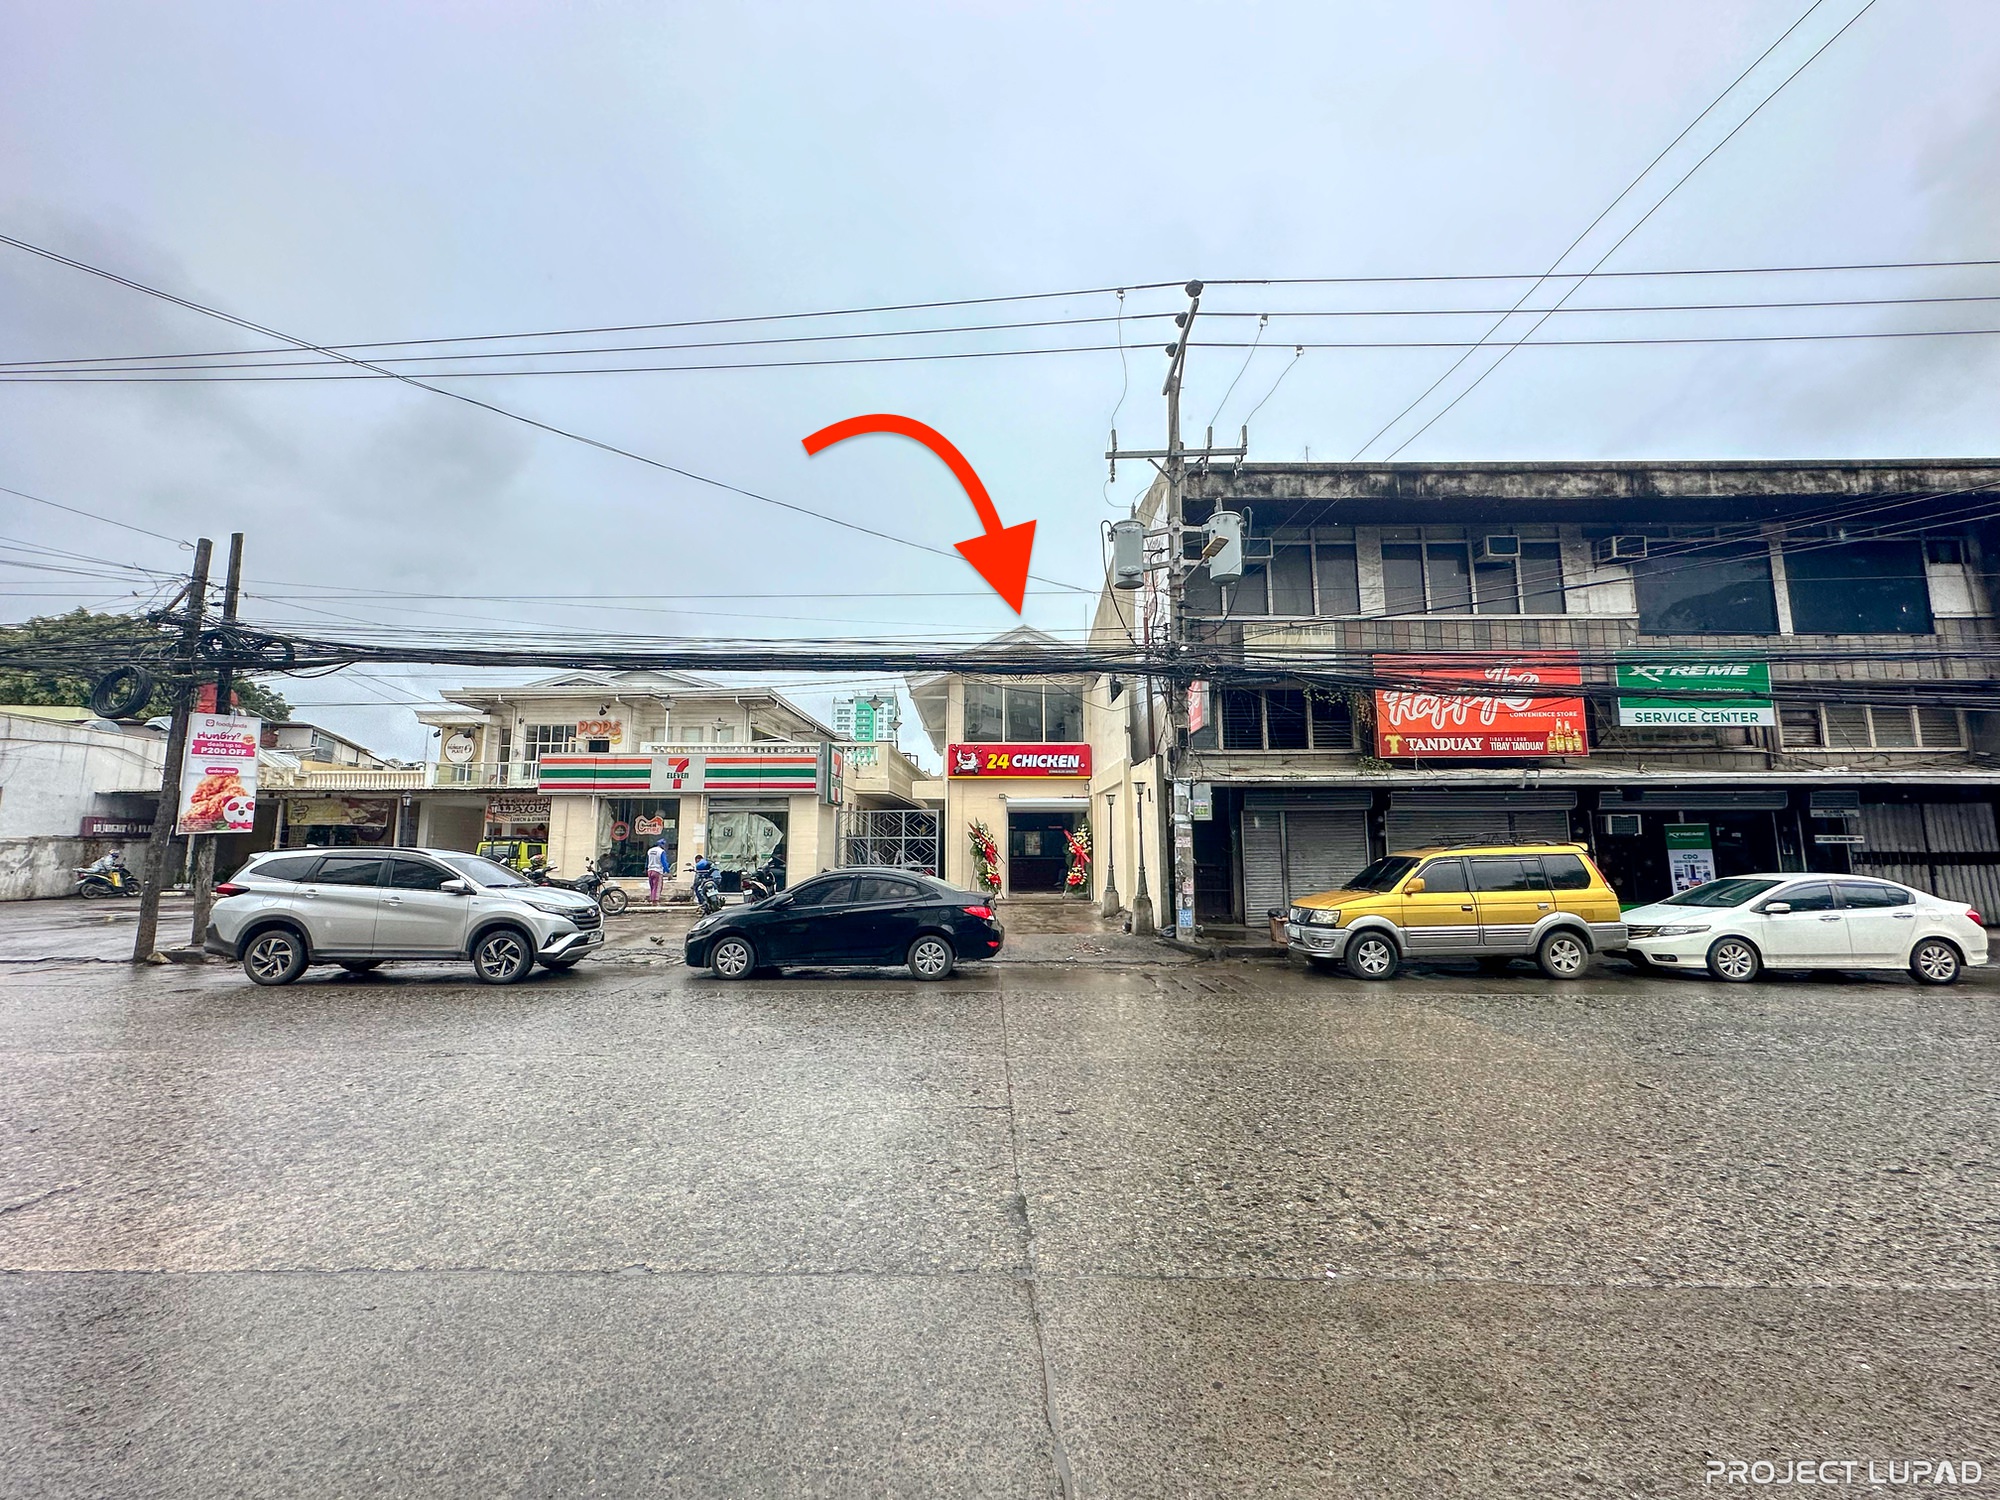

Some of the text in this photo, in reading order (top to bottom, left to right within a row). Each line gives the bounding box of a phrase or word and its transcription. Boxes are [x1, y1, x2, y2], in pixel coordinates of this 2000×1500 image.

[1628, 665, 1750, 683] XTREME
[1635, 712, 1759, 723] SERVICE CENTER
[216, 720, 248, 730] foodpanda
[207, 741, 225, 749] deals
[1406, 737, 1484, 751] TANDUAY
[1489, 742, 1545, 751] TIBAY TANDUAY
[228, 748, 247, 756] OFF
[986, 753, 1080, 770] 24 CHICKEN
[668, 757, 690, 789] 7
[1668, 831, 1705, 839] XTREME
